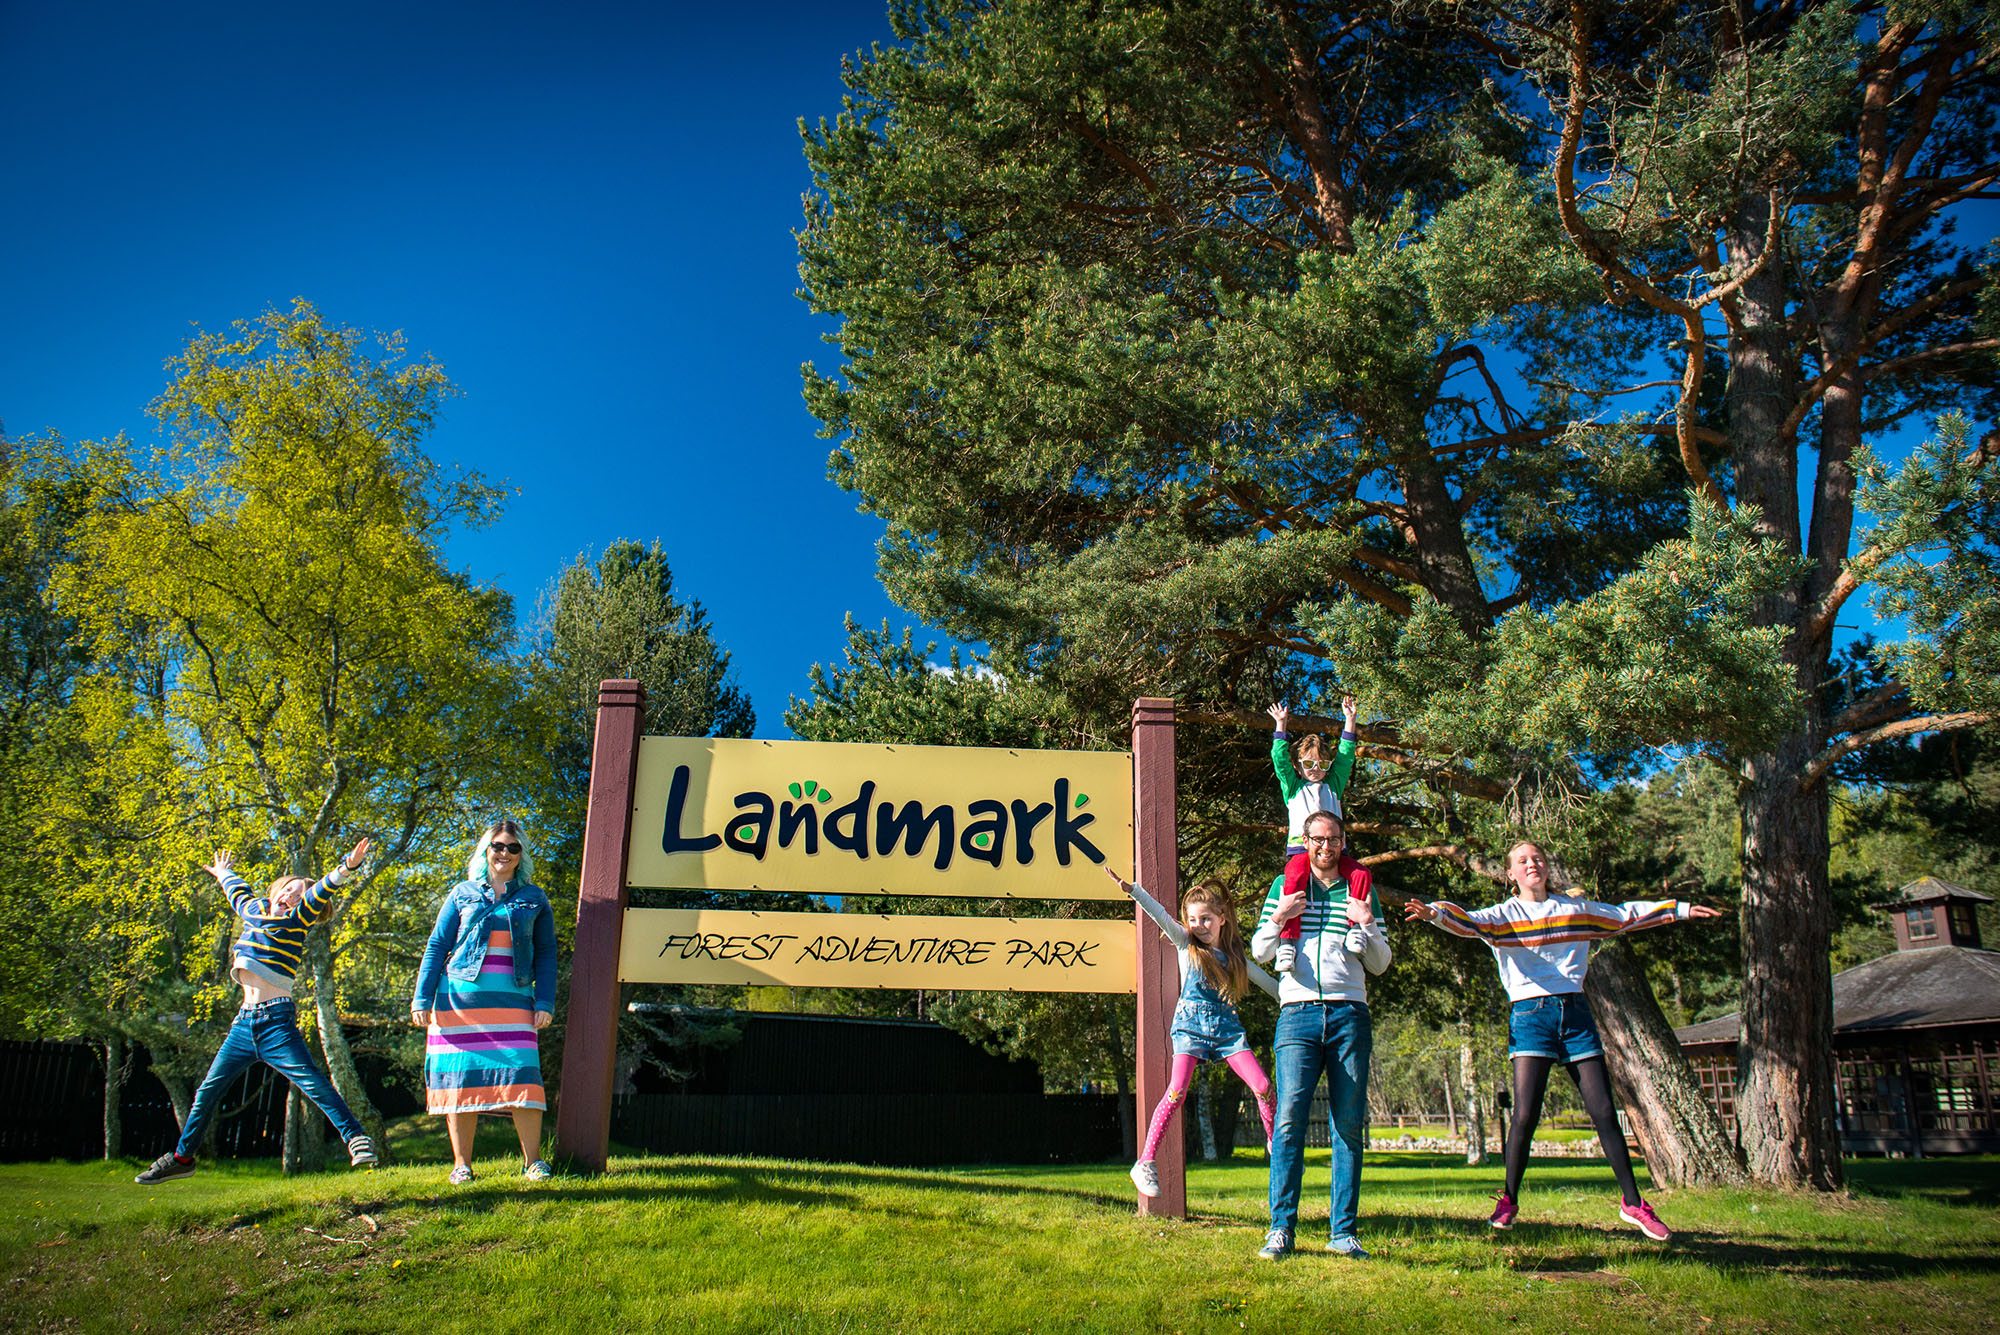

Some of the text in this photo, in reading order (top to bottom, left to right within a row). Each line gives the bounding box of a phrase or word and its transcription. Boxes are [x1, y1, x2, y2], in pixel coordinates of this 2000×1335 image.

[662, 765, 1106, 870] Landmark
[658, 932, 1100, 968] FOREST ADVENTURE PARK
